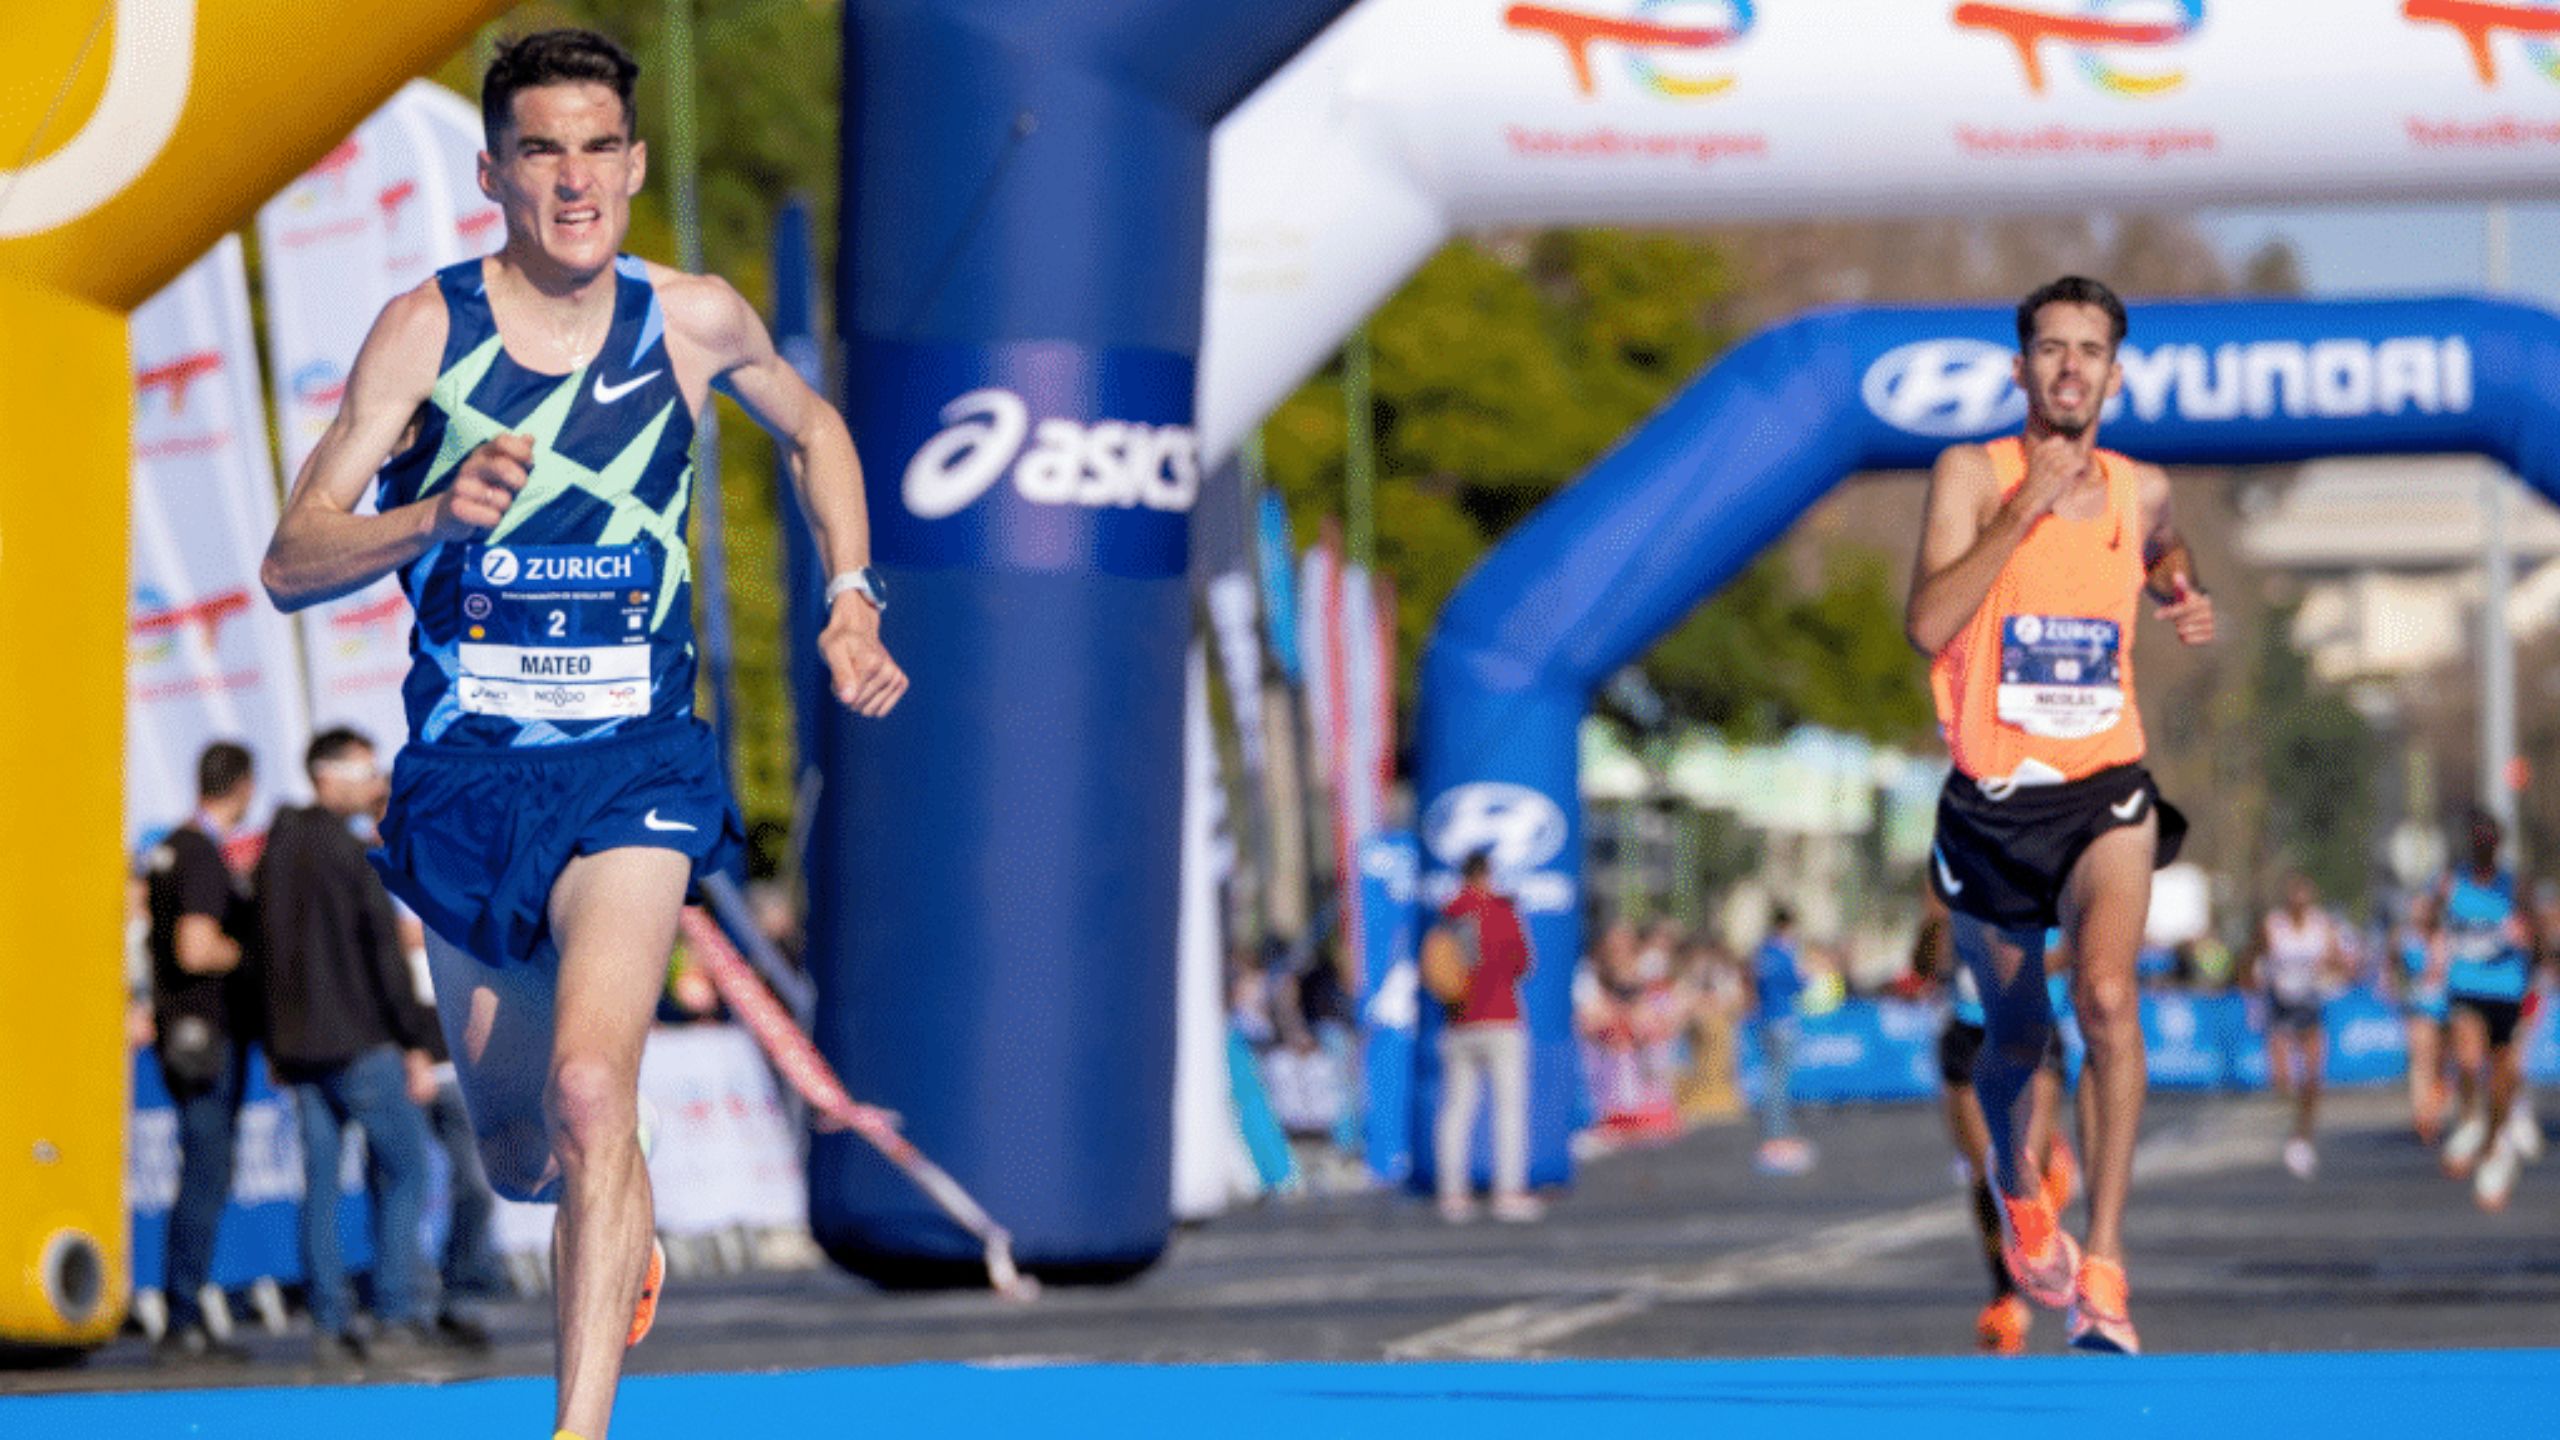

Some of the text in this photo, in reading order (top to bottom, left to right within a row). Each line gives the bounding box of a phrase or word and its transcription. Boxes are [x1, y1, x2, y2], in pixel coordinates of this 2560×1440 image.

[525, 556, 631, 580] ZURICH
[548, 609, 566, 638] 2
[521, 655, 591, 676] MATEO
